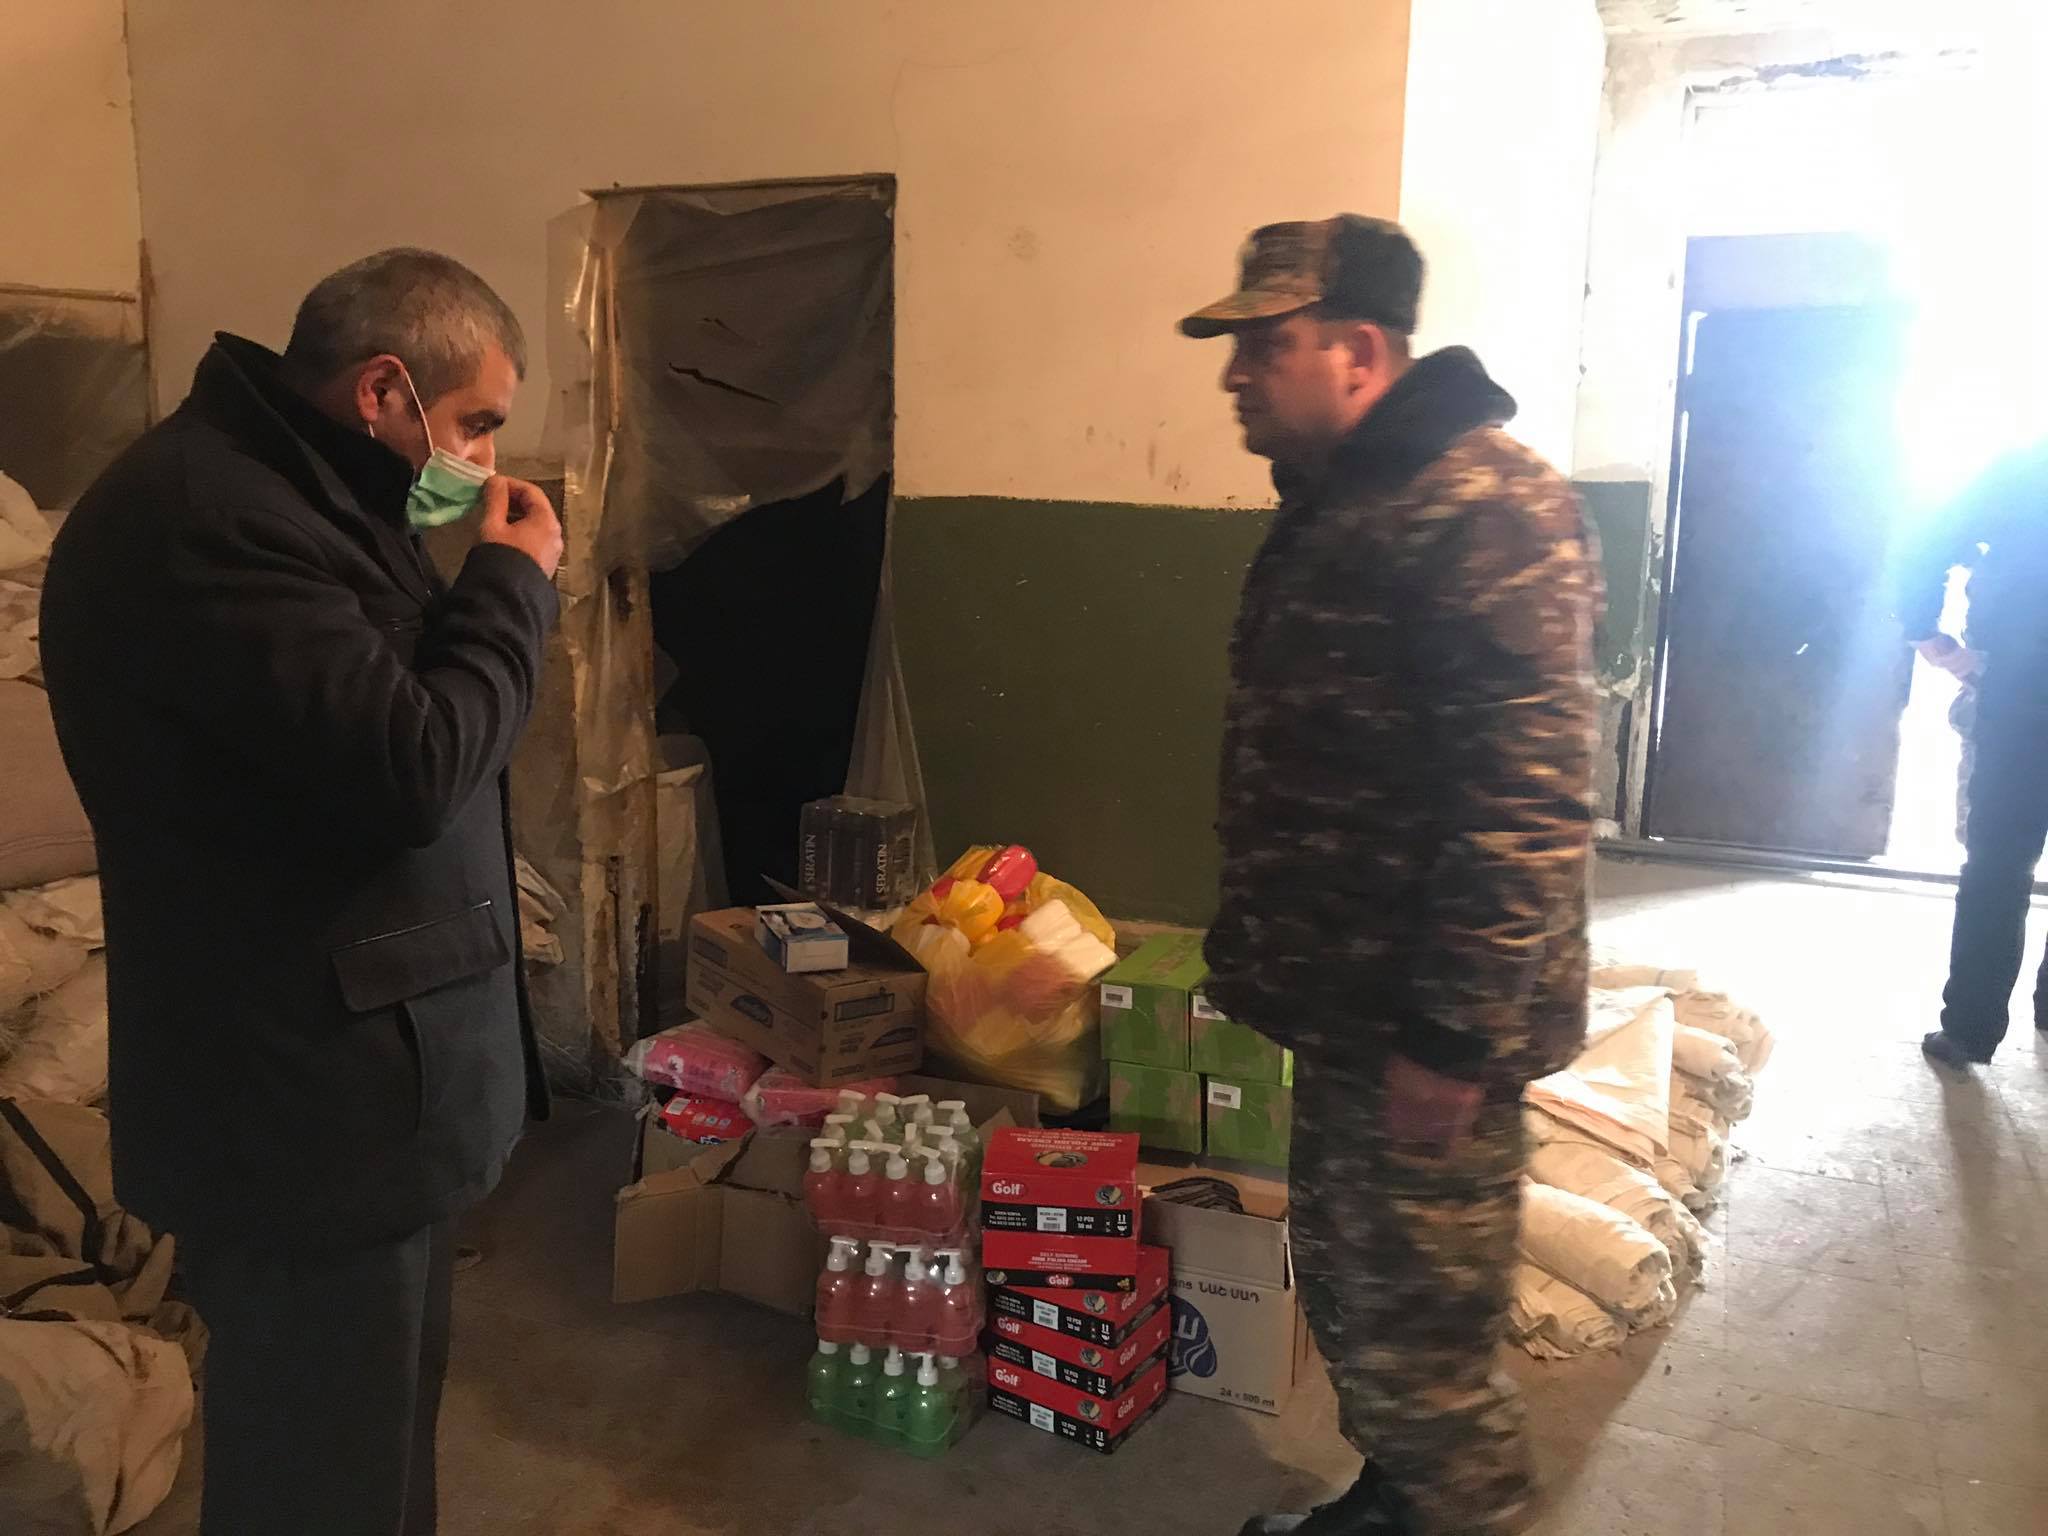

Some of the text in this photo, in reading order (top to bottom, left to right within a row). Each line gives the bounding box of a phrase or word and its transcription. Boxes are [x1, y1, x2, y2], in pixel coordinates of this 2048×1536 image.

[876, 843, 888, 894] SERATIN
[992, 1180, 1021, 1195] Golf
[1048, 1274, 1070, 1286] Golf
[996, 1317, 1020, 1335] Golf
[995, 1368, 1019, 1387] Golf
[1219, 1387, 1232, 1398] 24
[1261, 1399, 1275, 1408] ml
